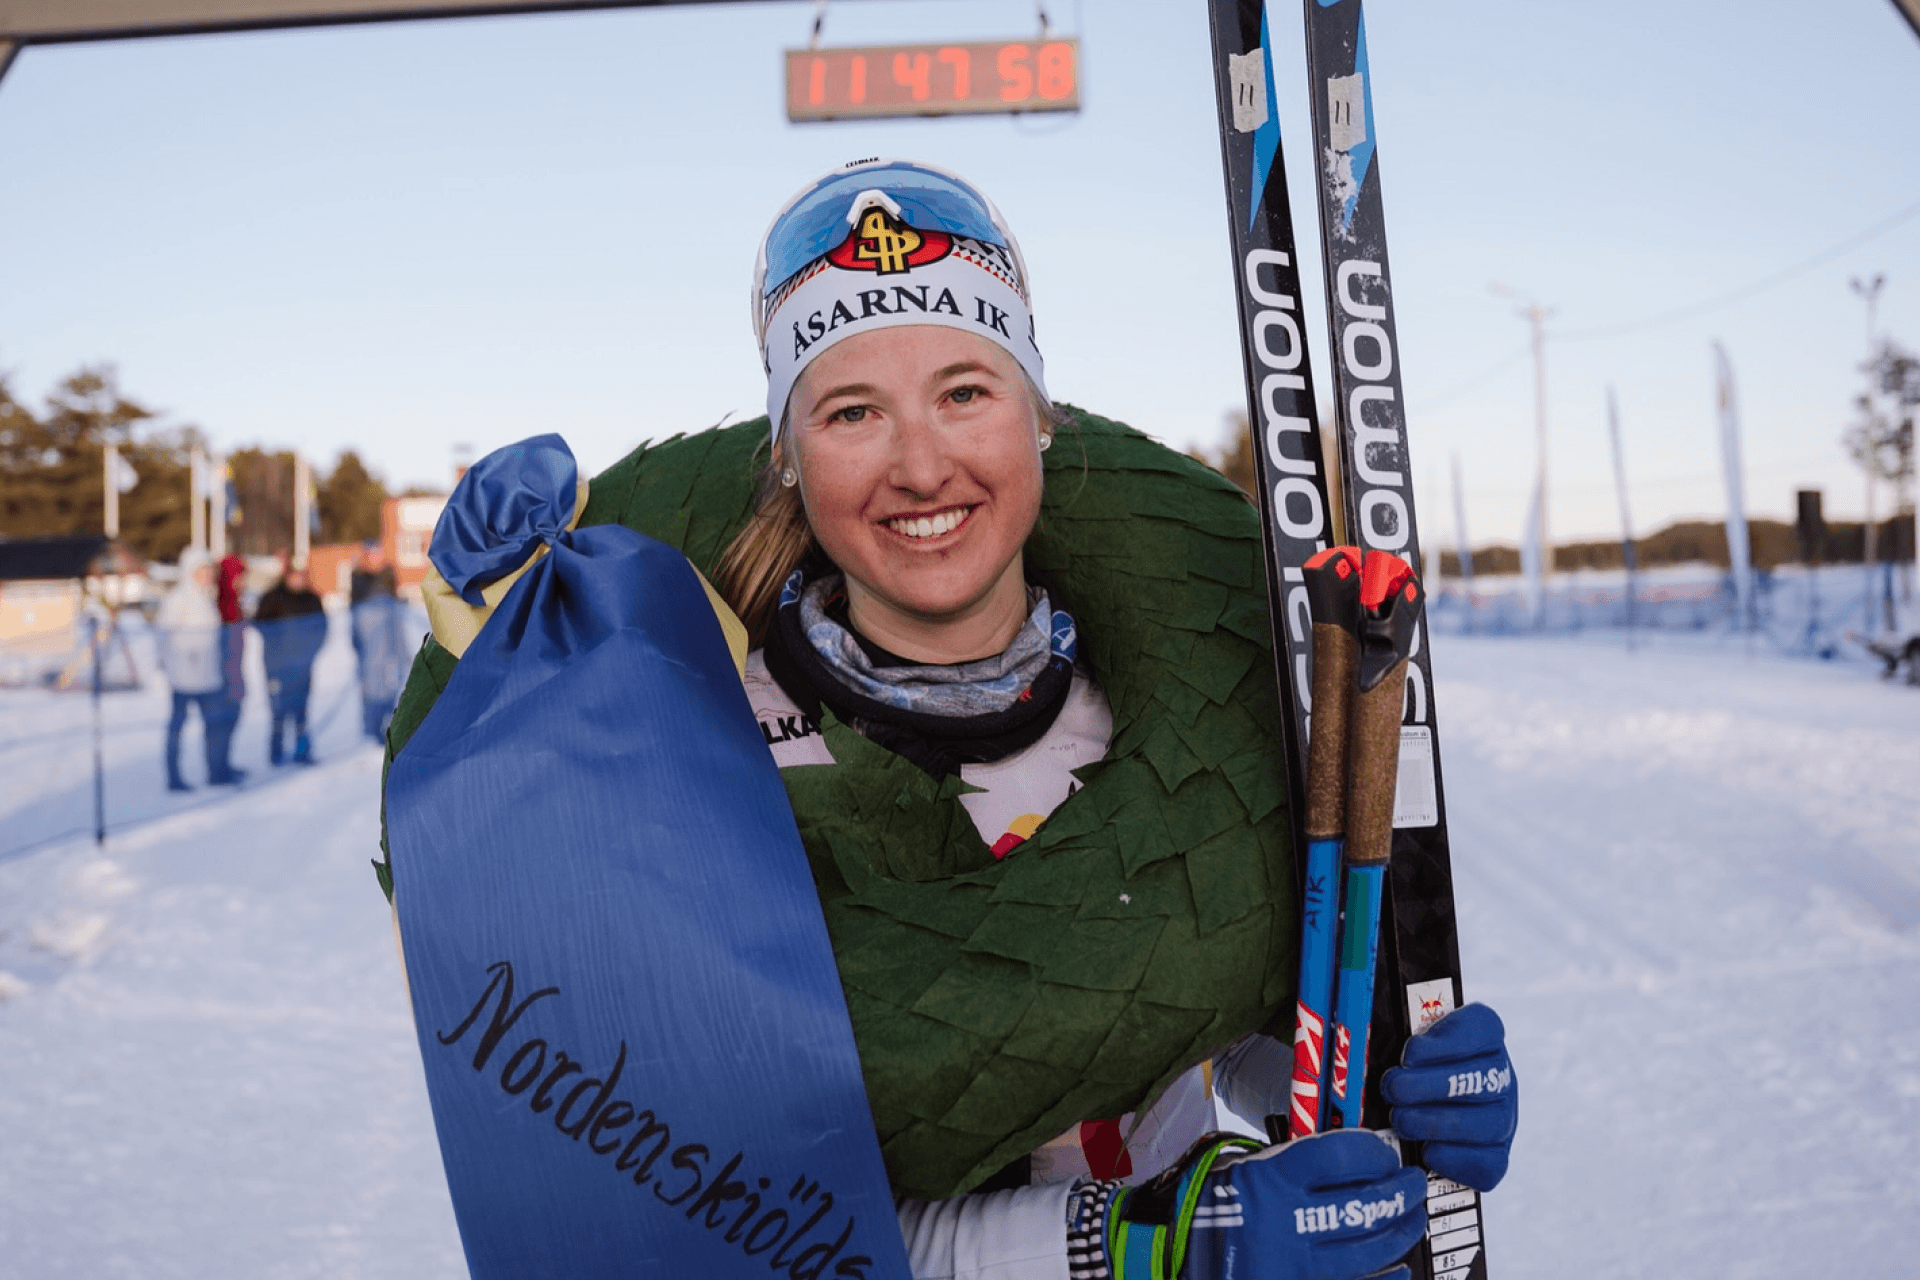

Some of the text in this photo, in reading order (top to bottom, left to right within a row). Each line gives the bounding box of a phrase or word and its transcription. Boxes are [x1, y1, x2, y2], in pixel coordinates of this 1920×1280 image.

[810, 43, 1075, 106] 11 47 58
[793, 285, 963, 362] ÅSARNA
[973, 296, 1011, 340] IK
